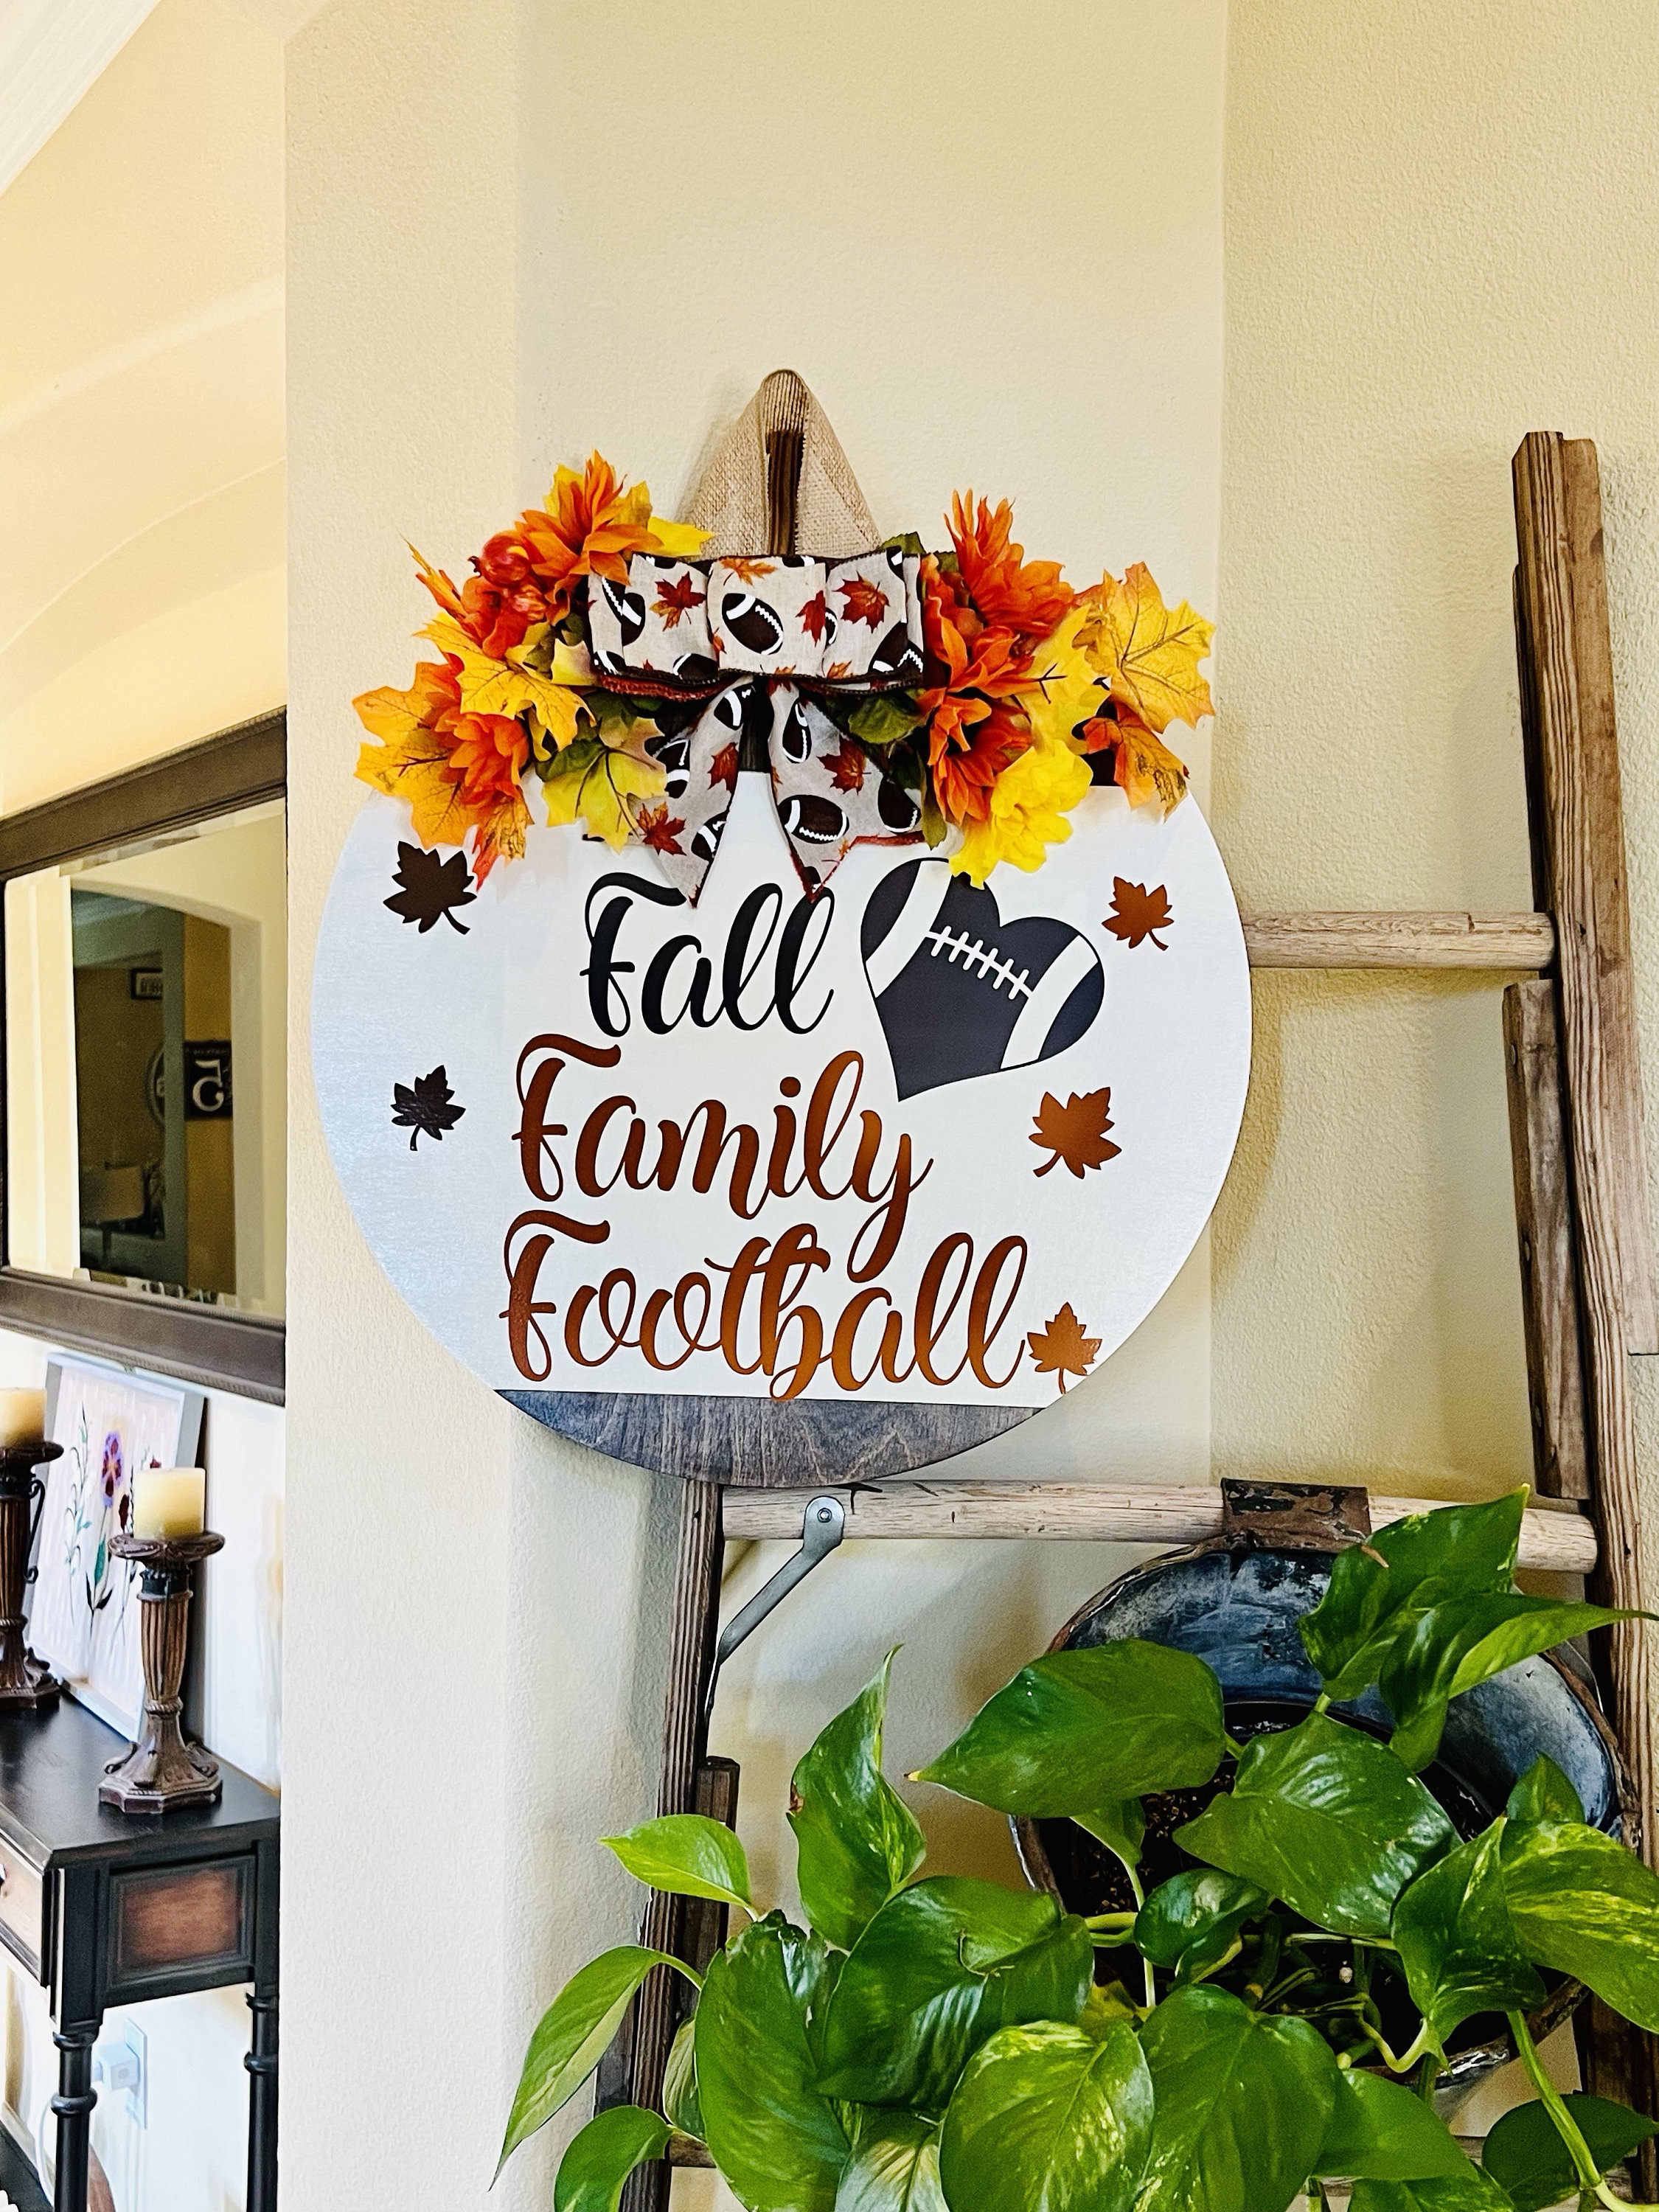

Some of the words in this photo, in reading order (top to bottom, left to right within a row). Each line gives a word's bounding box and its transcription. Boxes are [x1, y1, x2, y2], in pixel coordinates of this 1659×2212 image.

[579, 872, 836, 1037] Fall
[511, 1033, 934, 1283] Family
[498, 1209, 1029, 1401] Football
